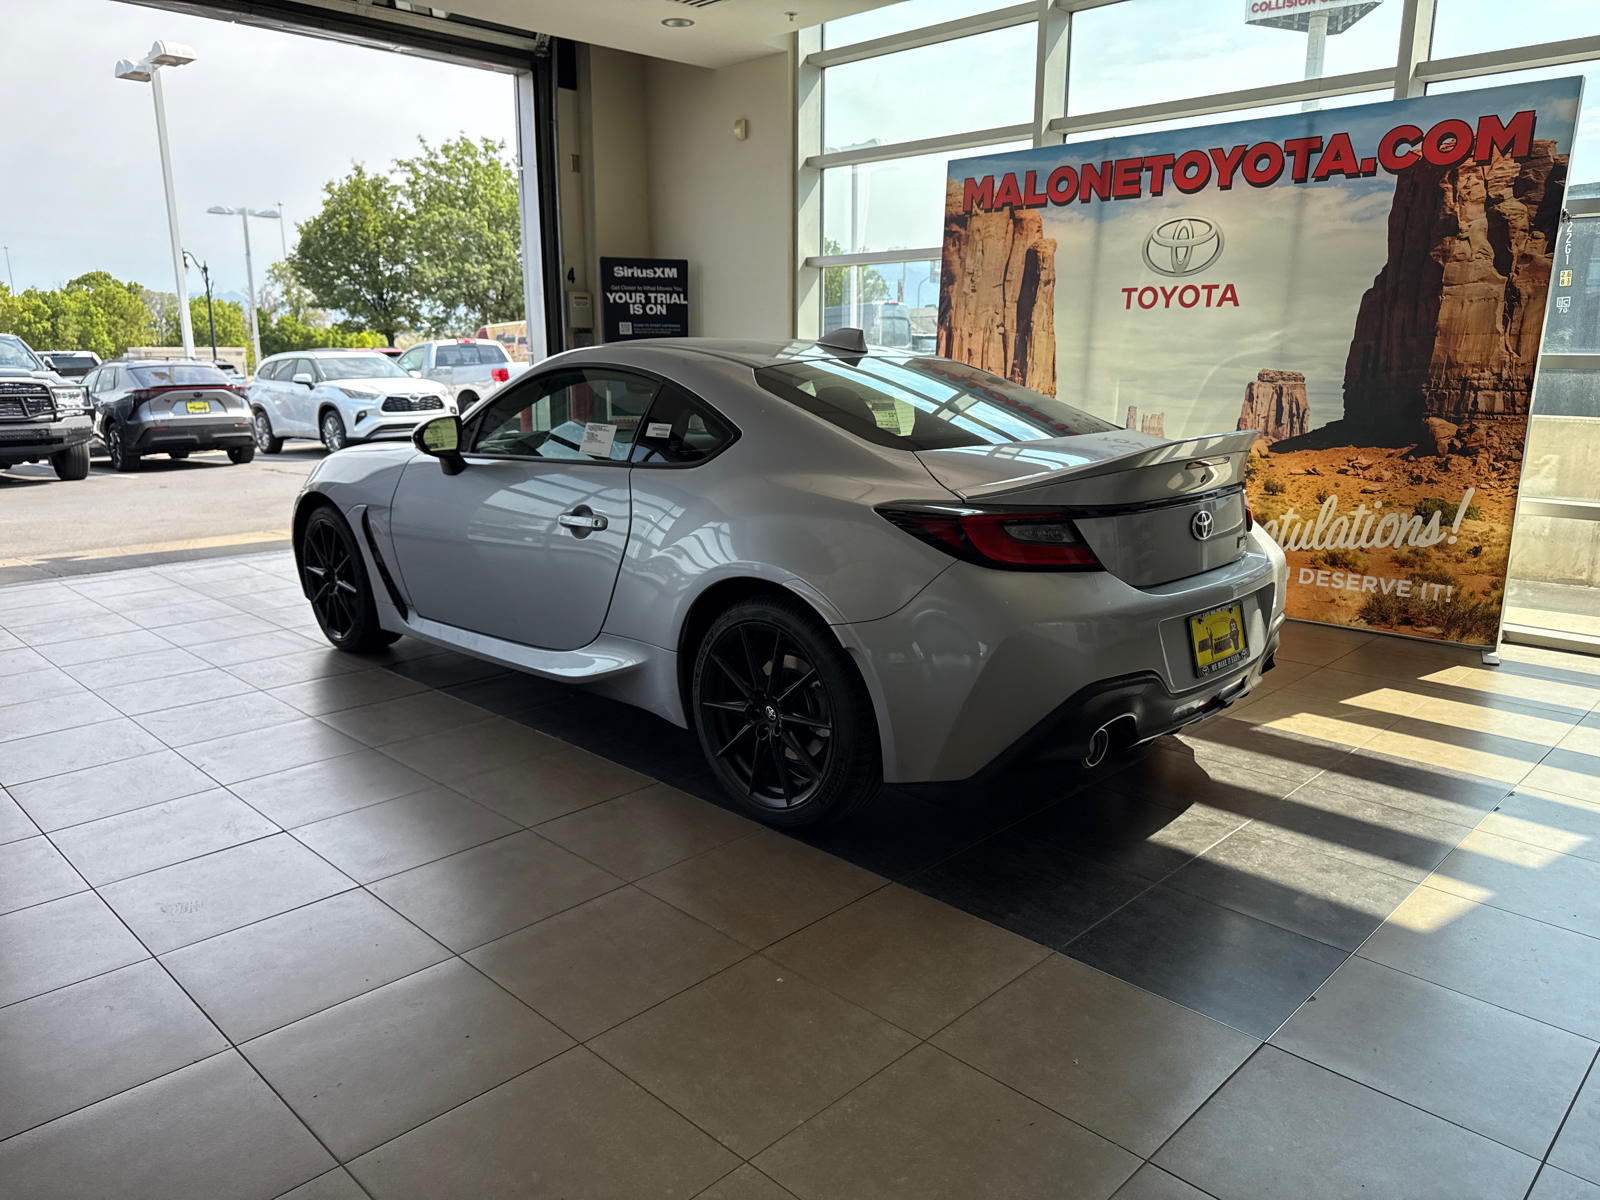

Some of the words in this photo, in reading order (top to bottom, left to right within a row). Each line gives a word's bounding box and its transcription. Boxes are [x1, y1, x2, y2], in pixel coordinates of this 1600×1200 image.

[1251, 0, 1316, 13] COLLISION
[963, 109, 1538, 213] MALONETOYOTA.COM
[567, 267, 575, 283] 4
[613, 266, 678, 278] SiriusXM
[606, 292, 645, 303] YOUR
[648, 293, 688, 304] TRIAL
[1121, 284, 1240, 310] TOYOTA
[630, 304, 643, 315] IS
[646, 304, 667, 316] ON
[1264, 487, 1475, 551] atulations!
[1299, 568, 1412, 597] DESERVE
[1421, 582, 1453, 603] IT!
